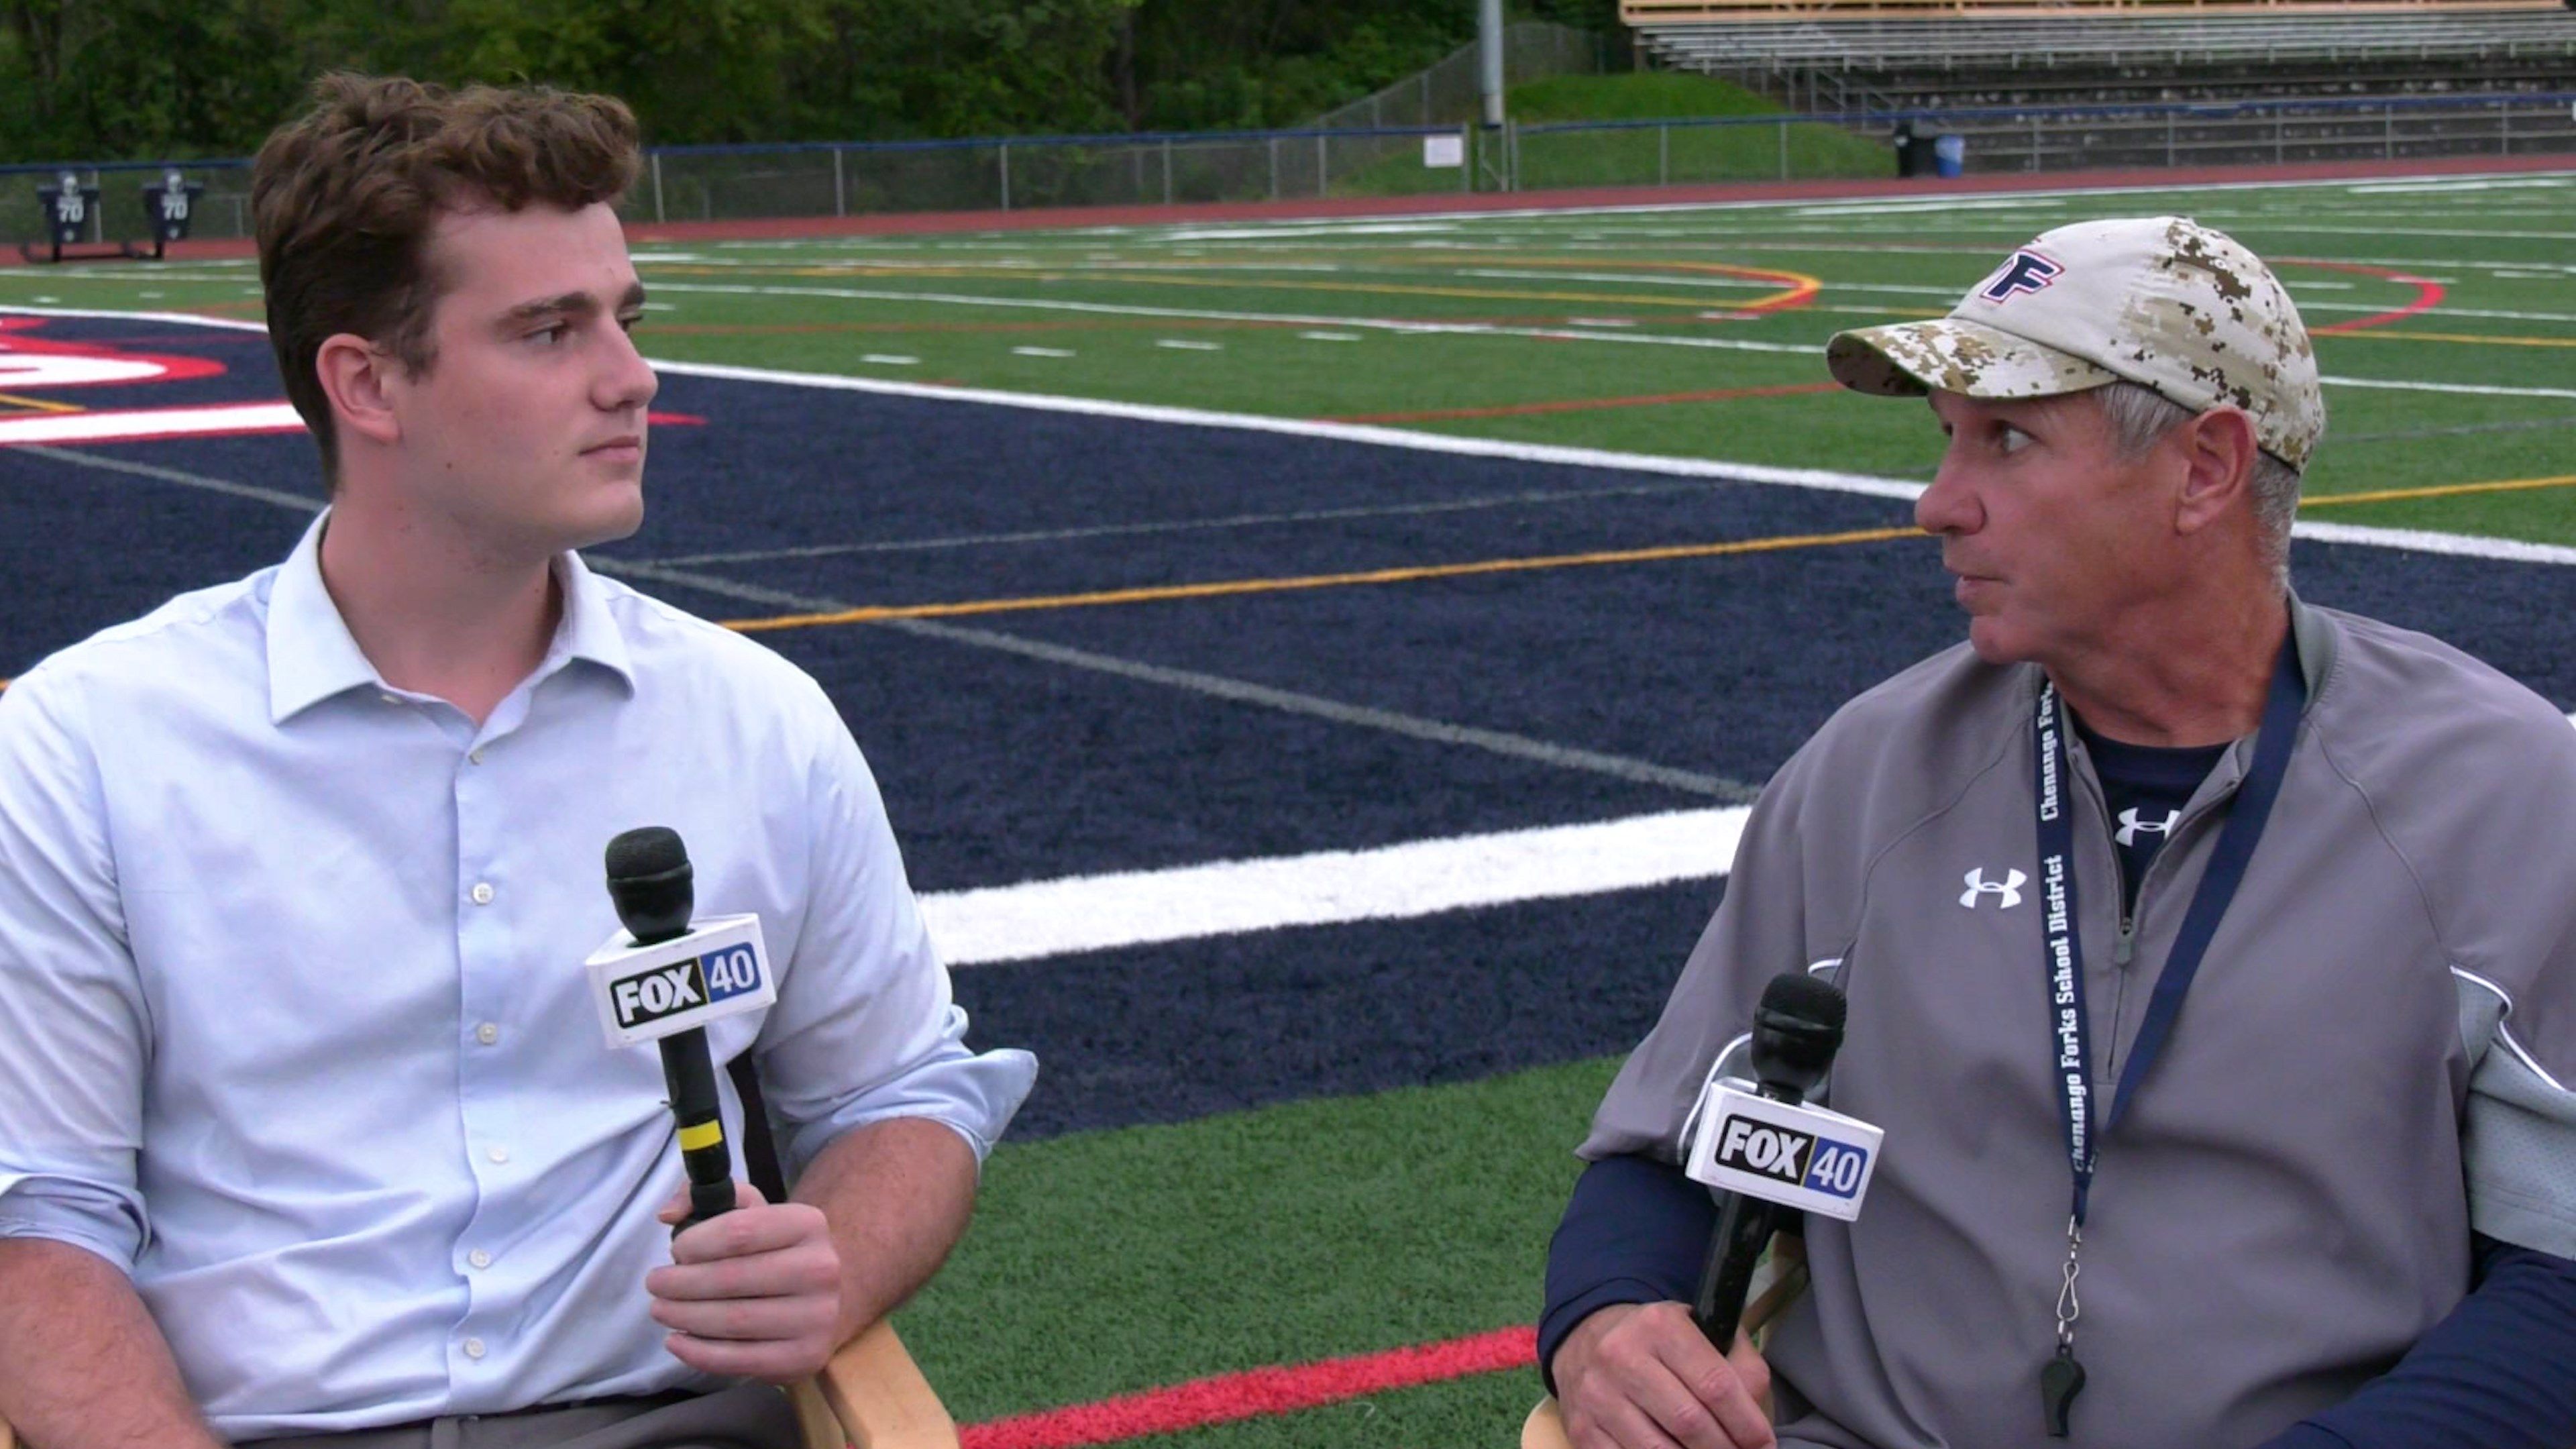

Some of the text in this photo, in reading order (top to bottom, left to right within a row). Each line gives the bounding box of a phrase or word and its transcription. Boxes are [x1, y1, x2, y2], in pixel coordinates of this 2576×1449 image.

[2040, 729, 2059, 821] Chenango
[2044, 855, 2068, 933] District
[615, 949, 755, 1024] FOX 40
[2050, 937, 2075, 1004] School
[2059, 1008, 2080, 1068] Forks
[1720, 1119, 1860, 1191] FOX 40
